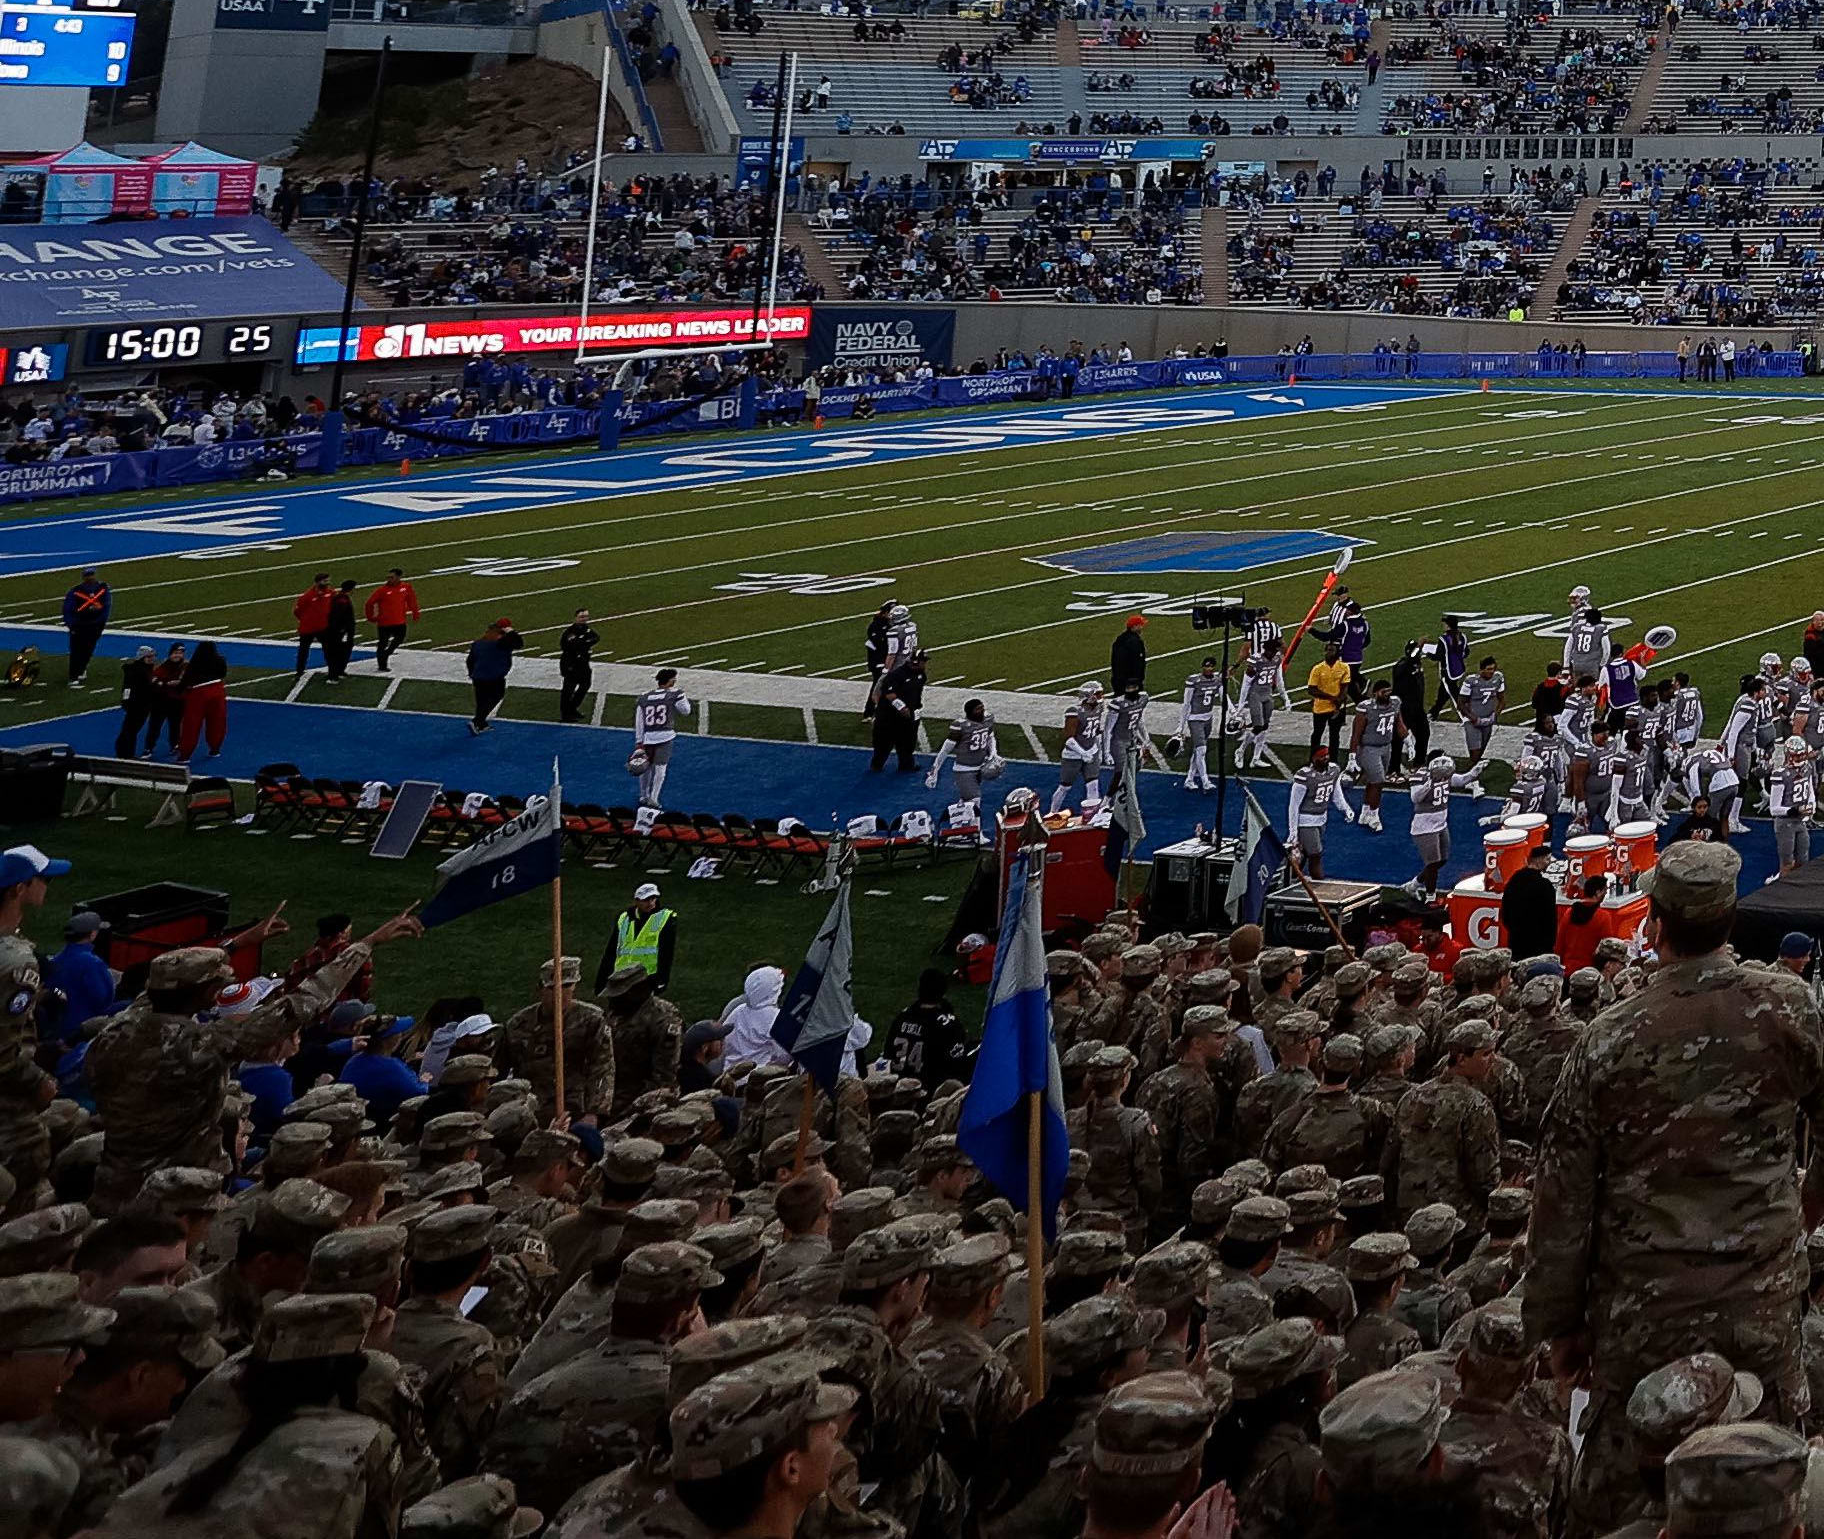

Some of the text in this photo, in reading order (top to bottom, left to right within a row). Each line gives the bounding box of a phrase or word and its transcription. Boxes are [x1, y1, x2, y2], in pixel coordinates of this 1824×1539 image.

[221, 0, 264, 12] USAA
[424, 333, 505, 355] NEWS
[519, 327, 573, 345] YOUR
[576, 322, 671, 342] BREAKING
[675, 318, 731, 336] NEWS
[734, 316, 805, 335] LEADER
[837, 323, 892, 338] NAVY
[107, 325, 271, 361] 15:00 25
[835, 337, 921, 351] FEDERAL
[834, 355, 920, 369] Credit Union
[14, 369, 49, 383] USAA
[1196, 371, 1223, 382] USAA
[430, 556, 582, 577] 10
[713, 571, 898, 596] 20
[1577, 634, 1593, 653] 18
[1203, 690, 1212, 707] 5
[1480, 691, 1491, 705] 7
[644, 703, 668, 729] 83
[1375, 717, 1394, 736] 44
[1485, 852, 1498, 870] G
[1617, 845, 1629, 863] G
[1569, 858, 1584, 876] G
[491, 864, 516, 890] 18
[1467, 907, 1500, 950] G
[893, 1036, 925, 1074] 34
